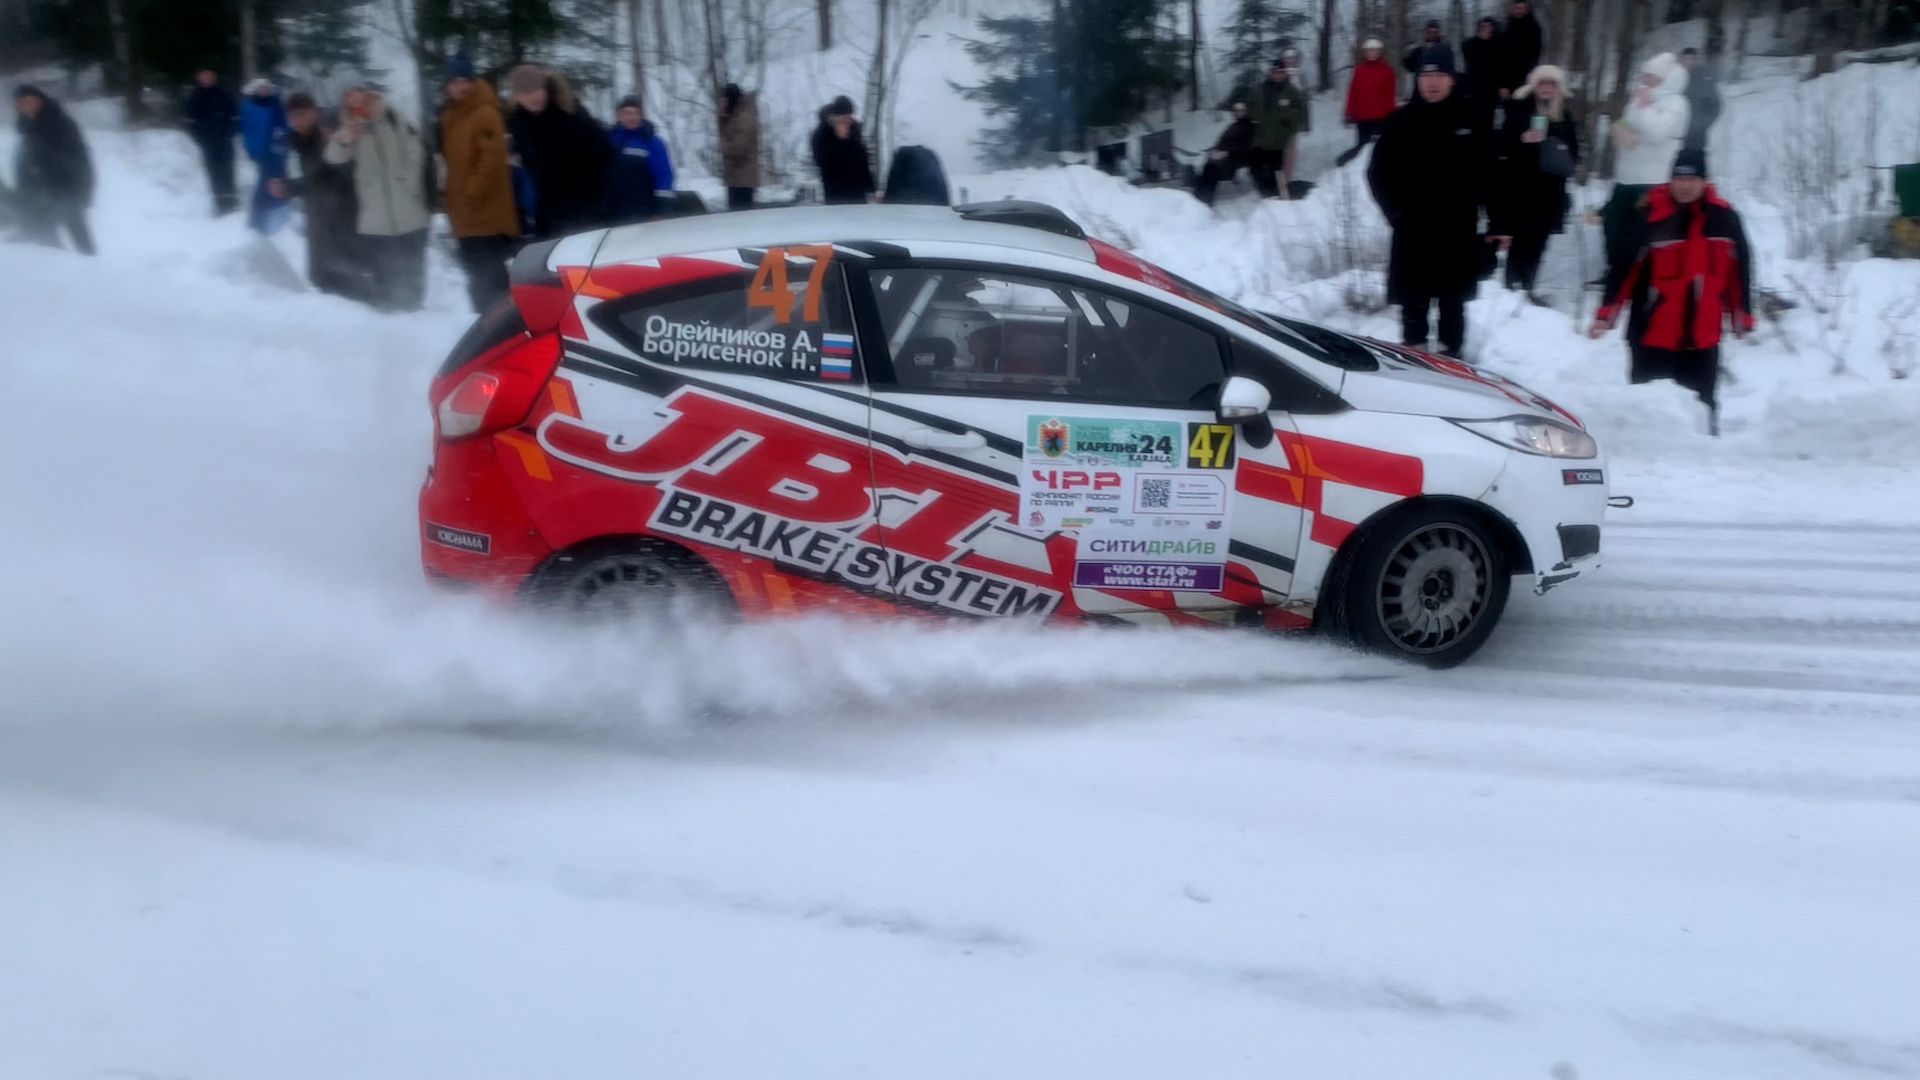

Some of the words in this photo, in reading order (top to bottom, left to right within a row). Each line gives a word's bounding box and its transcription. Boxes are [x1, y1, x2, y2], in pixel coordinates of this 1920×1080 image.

[748, 245, 834, 324] 47
[645, 315, 786, 350] Олейников
[792, 330, 817, 353] А.
[643, 333, 782, 368] Борисенок
[1076, 441, 1137, 453] КАРЕЛИЯ
[1189, 424, 1233, 468] 47
[1032, 470, 1121, 490] ЧРР
[1031, 492, 1083, 500] ЧЕМПИОНАТ
[656, 490, 841, 572] BRAKE
[847, 546, 1053, 617] SYSTEM
[1090, 539, 1216, 555] СИТИДРАЙВ
[1103, 576, 1195, 588] www.staf.ru
